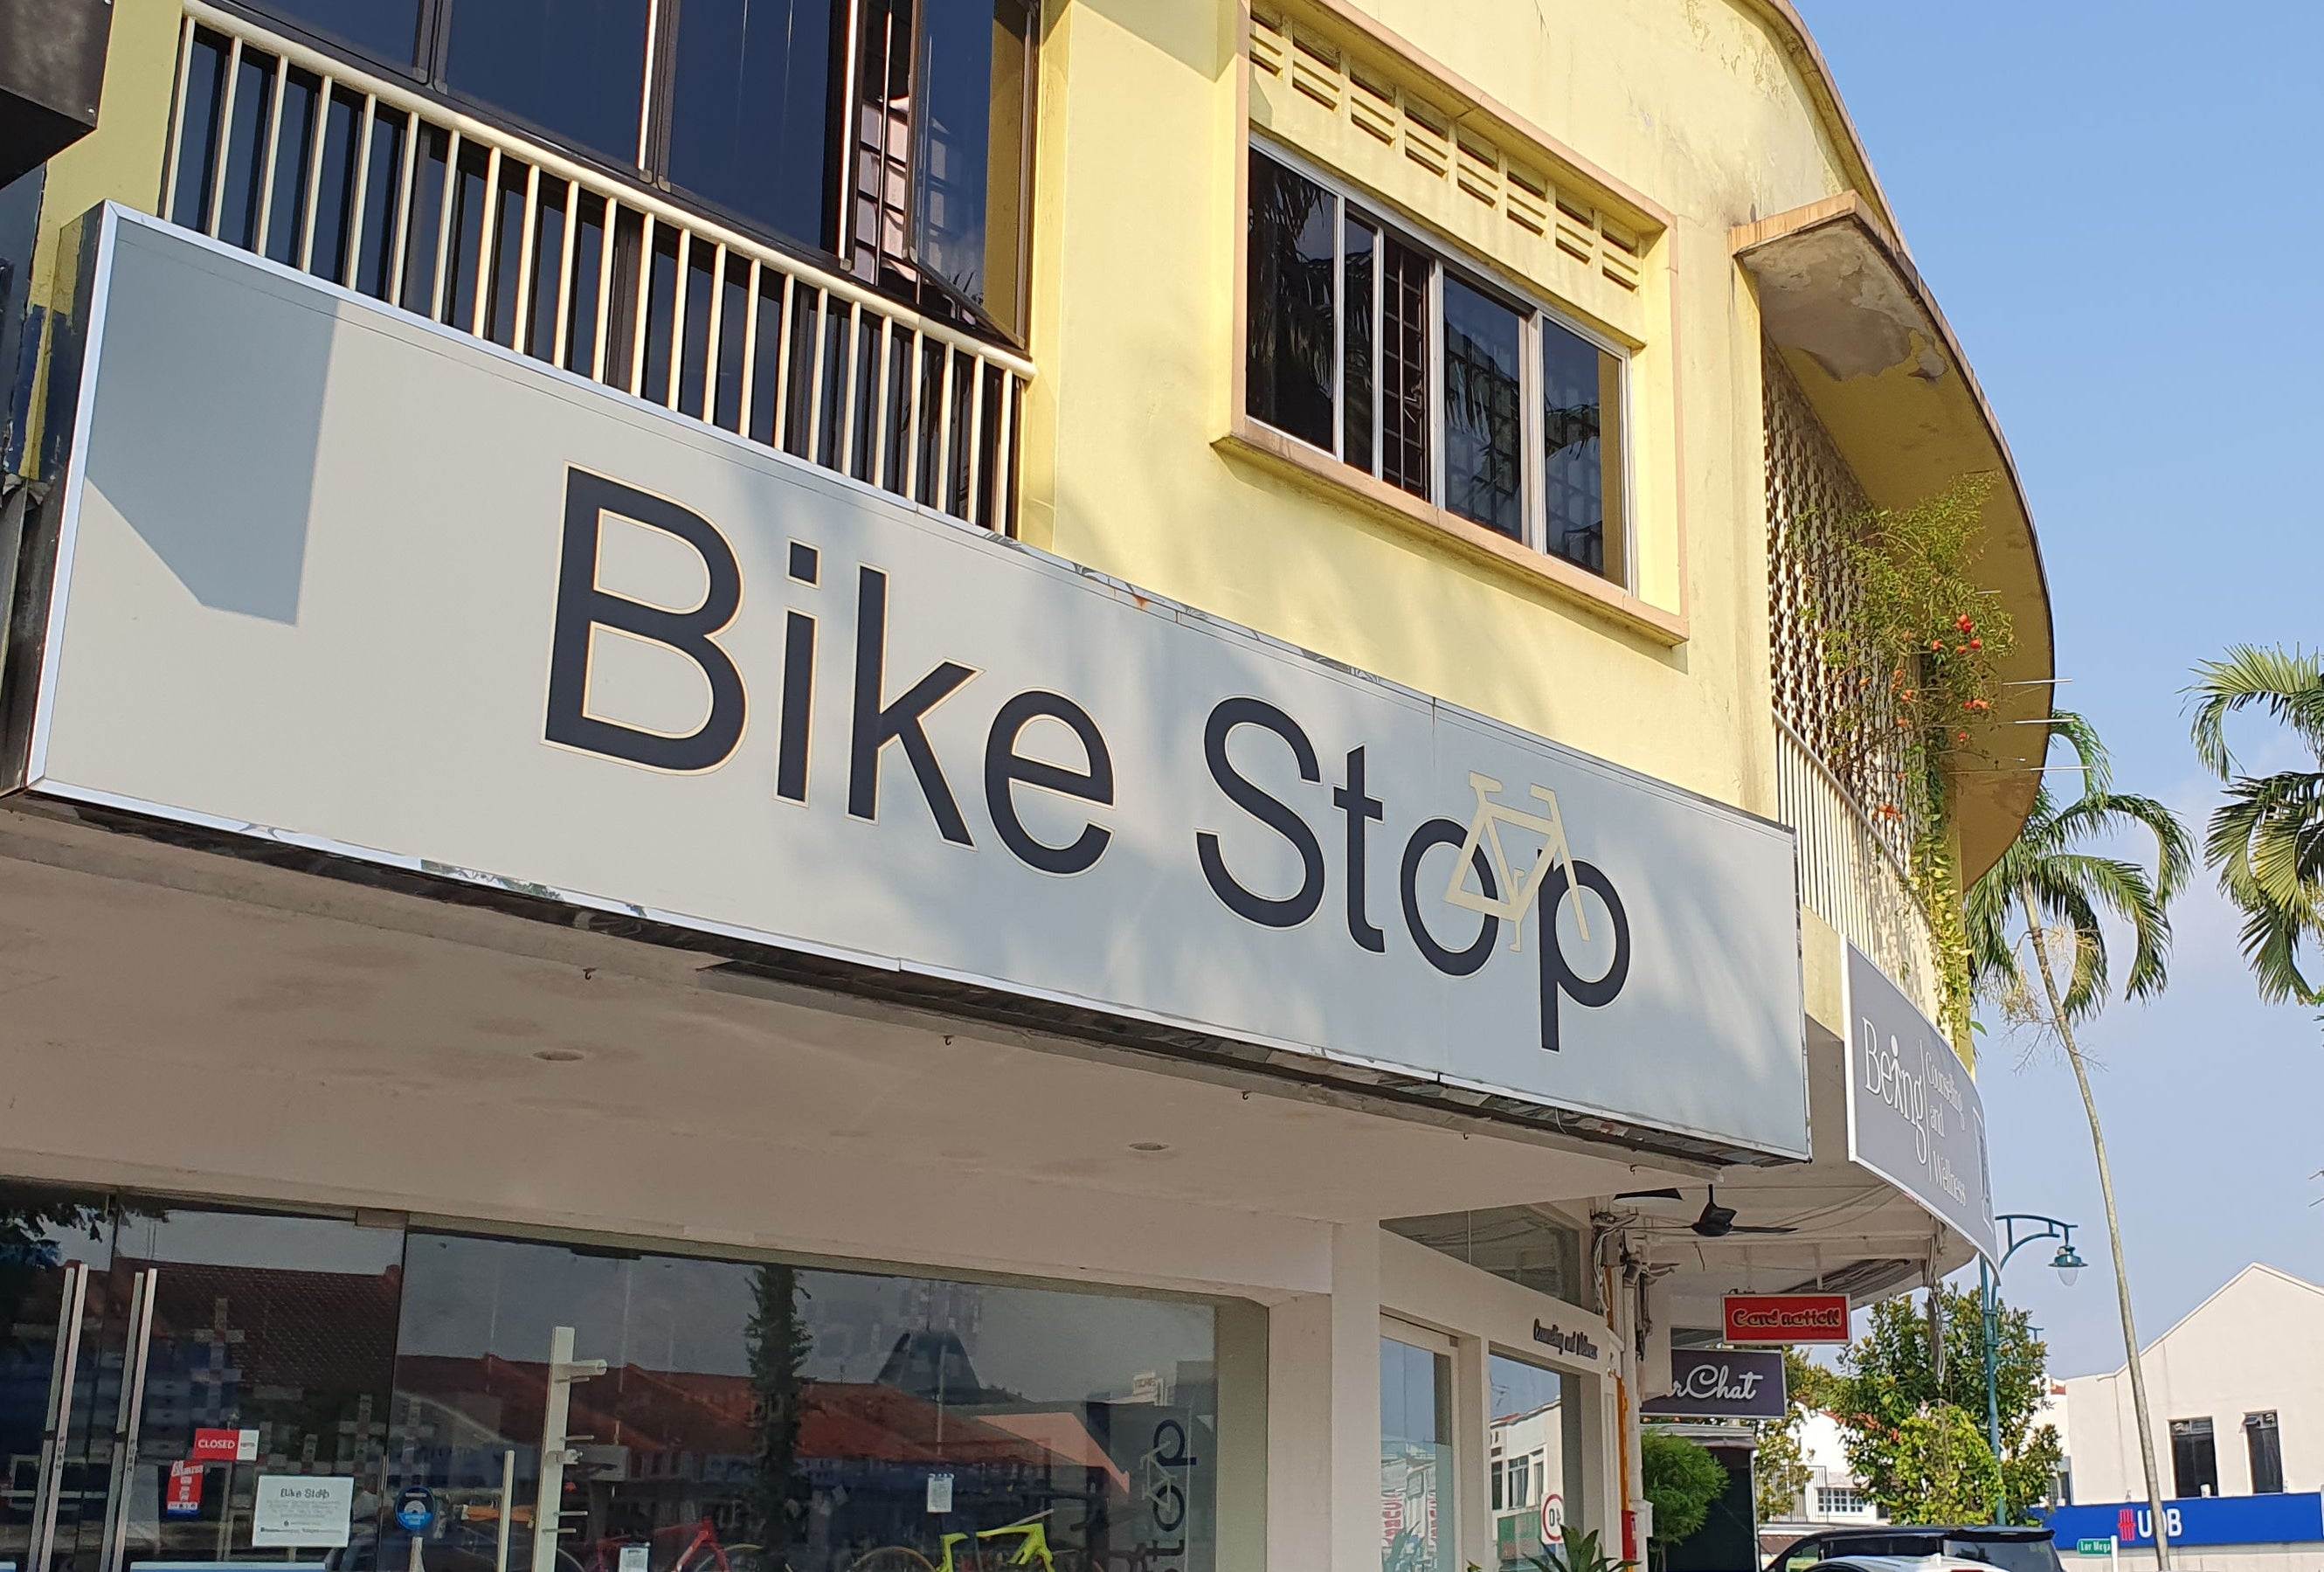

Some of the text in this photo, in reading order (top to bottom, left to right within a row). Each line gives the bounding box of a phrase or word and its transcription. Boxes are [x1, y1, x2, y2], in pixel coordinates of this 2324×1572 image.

[541, 461, 1631, 1053] Bike Stop
[1862, 1016, 1926, 1165] Being
[1929, 1104, 1945, 1138] and
[1666, 1364, 1763, 1400] rChat
[197, 1438, 236, 1449] CLOSED
[1145, 1418, 1197, 1572] top
